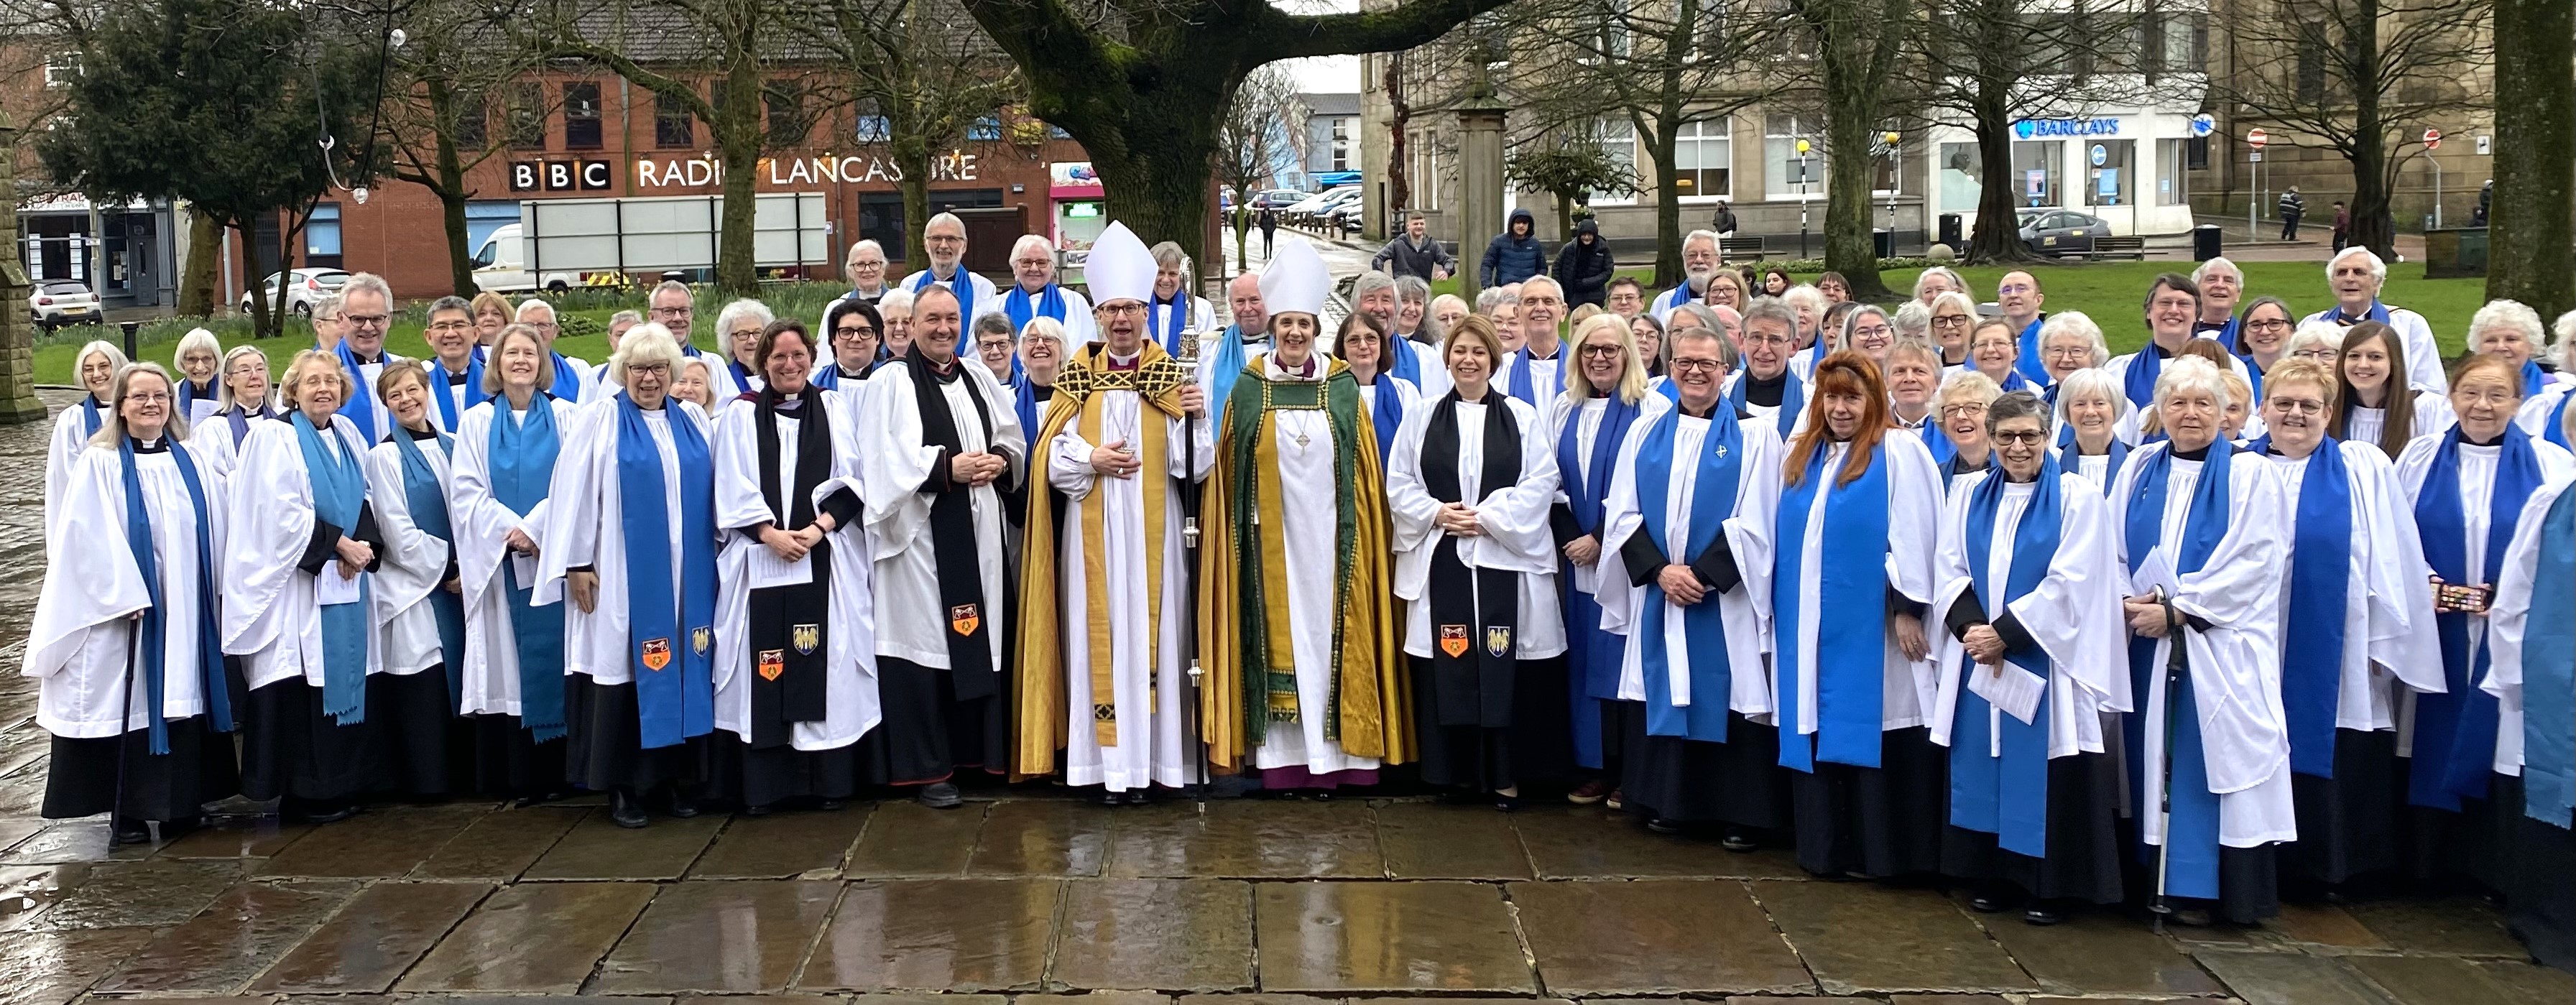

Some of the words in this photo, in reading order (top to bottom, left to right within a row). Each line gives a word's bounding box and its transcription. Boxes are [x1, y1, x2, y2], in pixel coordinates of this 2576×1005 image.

[2036, 119, 2120, 136] BARCLAYS
[516, 163, 606, 187] BBC
[639, 159, 726, 187] RADI
[770, 154, 977, 185] LANCASIRE
